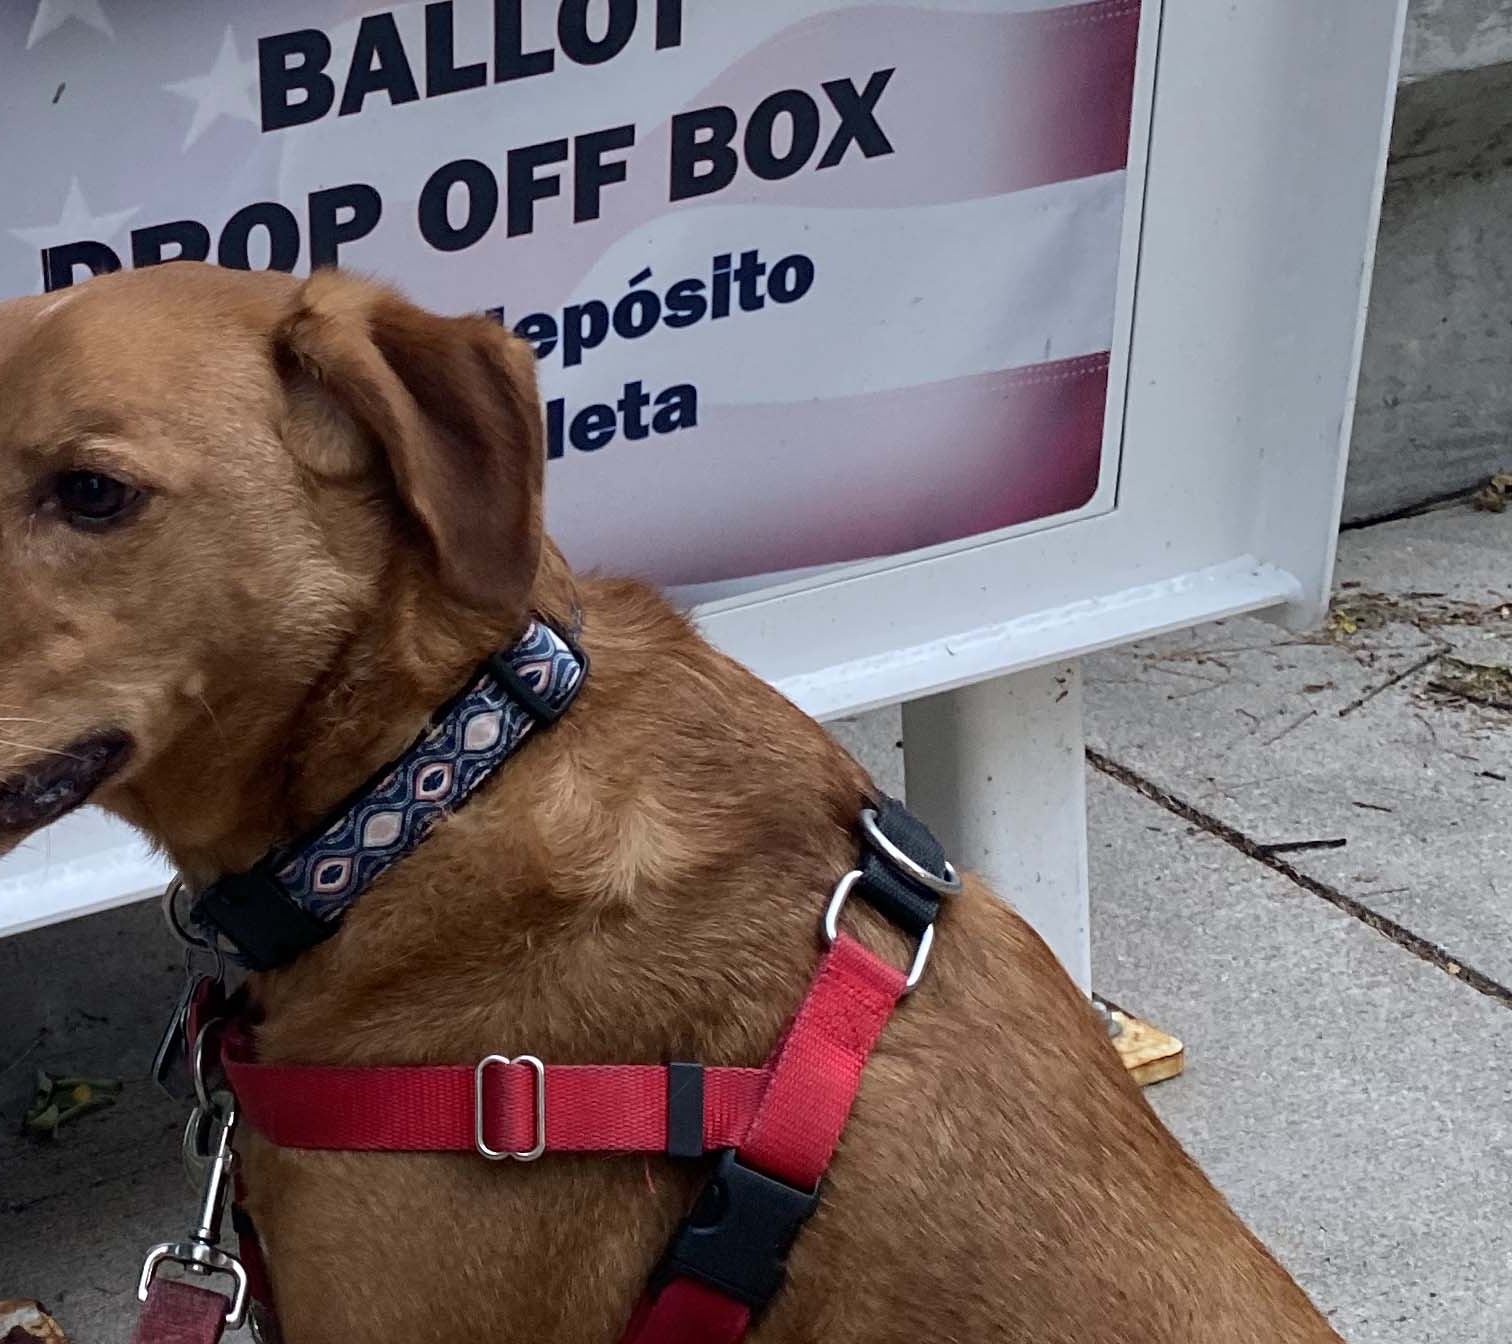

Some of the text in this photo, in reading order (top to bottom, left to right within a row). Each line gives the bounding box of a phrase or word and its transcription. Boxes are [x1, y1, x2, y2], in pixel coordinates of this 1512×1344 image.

[418, 124, 636, 251] OFF
[668, 67, 897, 203] BOX
[485, 249, 815, 368] epósito
[546, 380, 698, 460] leta
